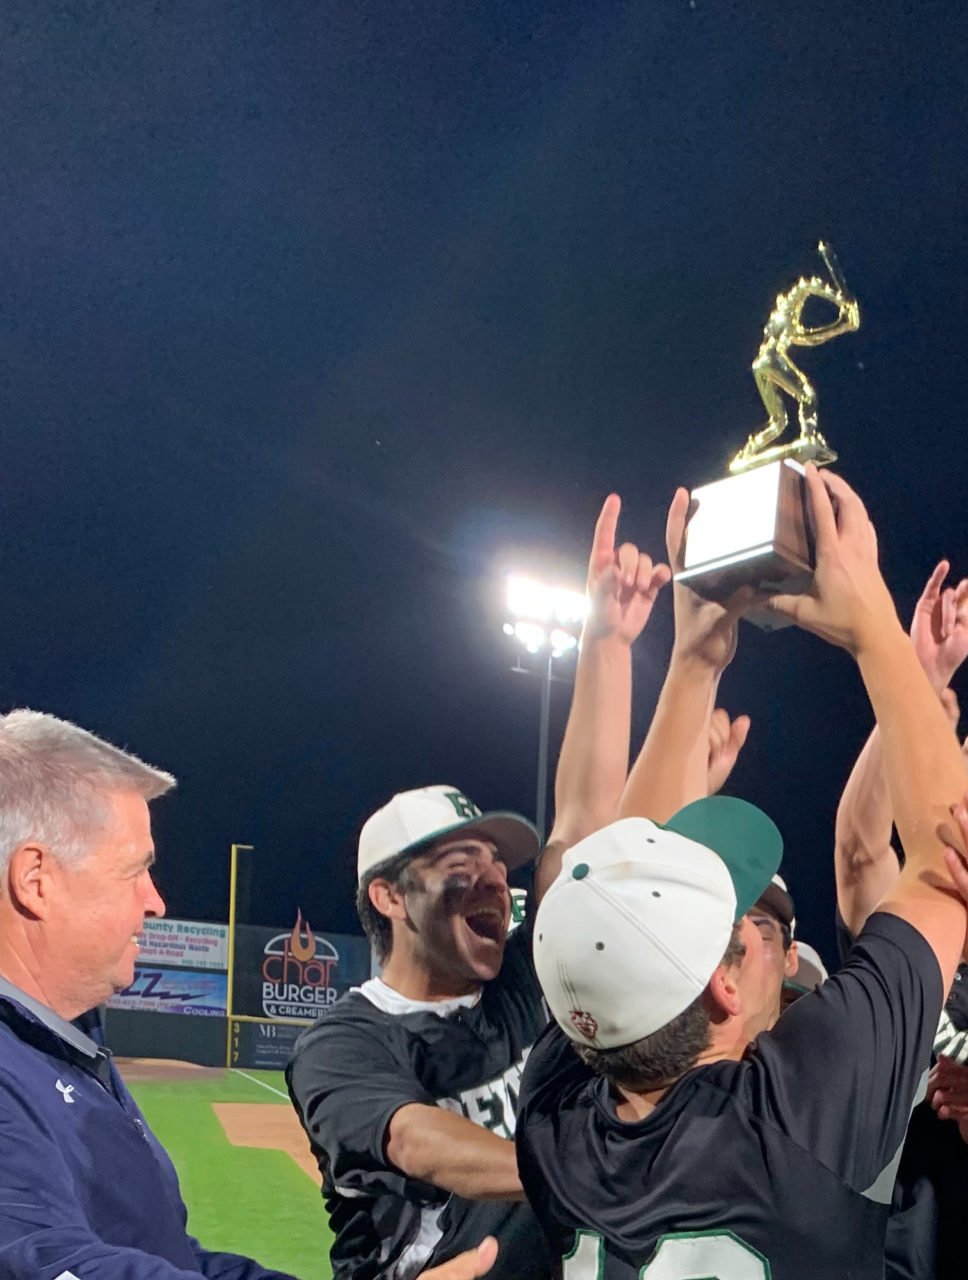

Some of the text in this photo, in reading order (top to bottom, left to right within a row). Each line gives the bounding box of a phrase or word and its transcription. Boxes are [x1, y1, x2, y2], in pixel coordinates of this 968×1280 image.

[143, 921, 226, 939] ounty Recycling
[262, 938, 338, 988] char
[262, 981, 338, 1005] BURGER
[269, 1004, 277, 1015] &
